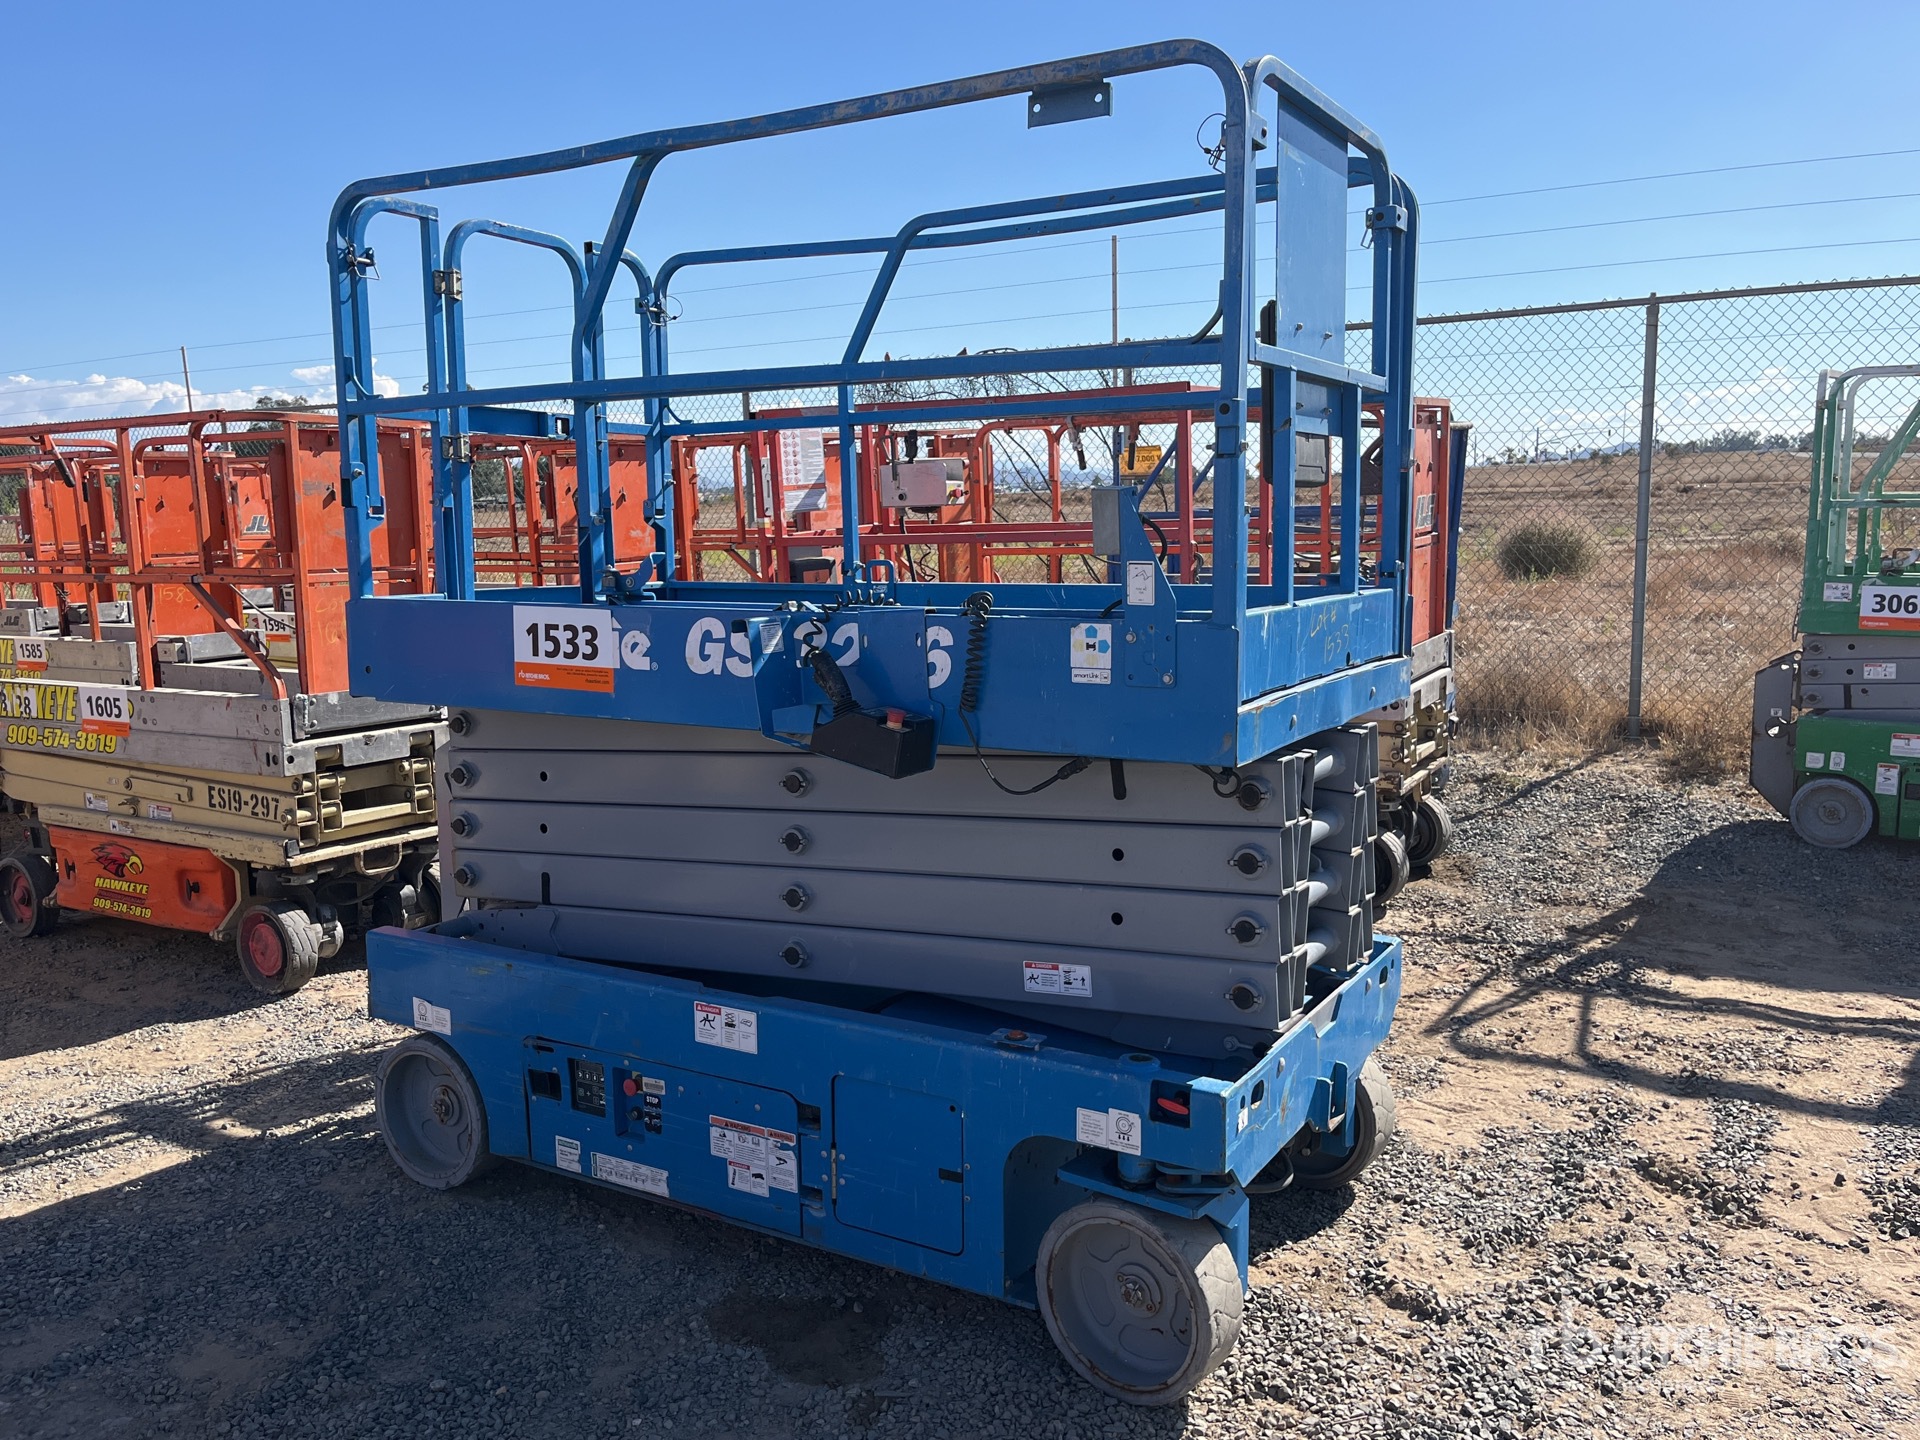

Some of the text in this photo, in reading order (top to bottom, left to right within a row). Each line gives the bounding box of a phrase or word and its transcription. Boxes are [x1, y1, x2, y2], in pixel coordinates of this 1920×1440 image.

[1871, 593, 1920, 615] 306
[4, 615, 20, 626] JLG
[20, 643, 43, 659] 1585
[526, 622, 599, 662] 1533
[86, 695, 123, 719] 1605
[7, 724, 118, 753] 909-574-3819
[94, 876, 150, 895] HAWKEYE
[93, 896, 152, 918] 909-574-3819
[646, 1095, 659, 1105] STOP
